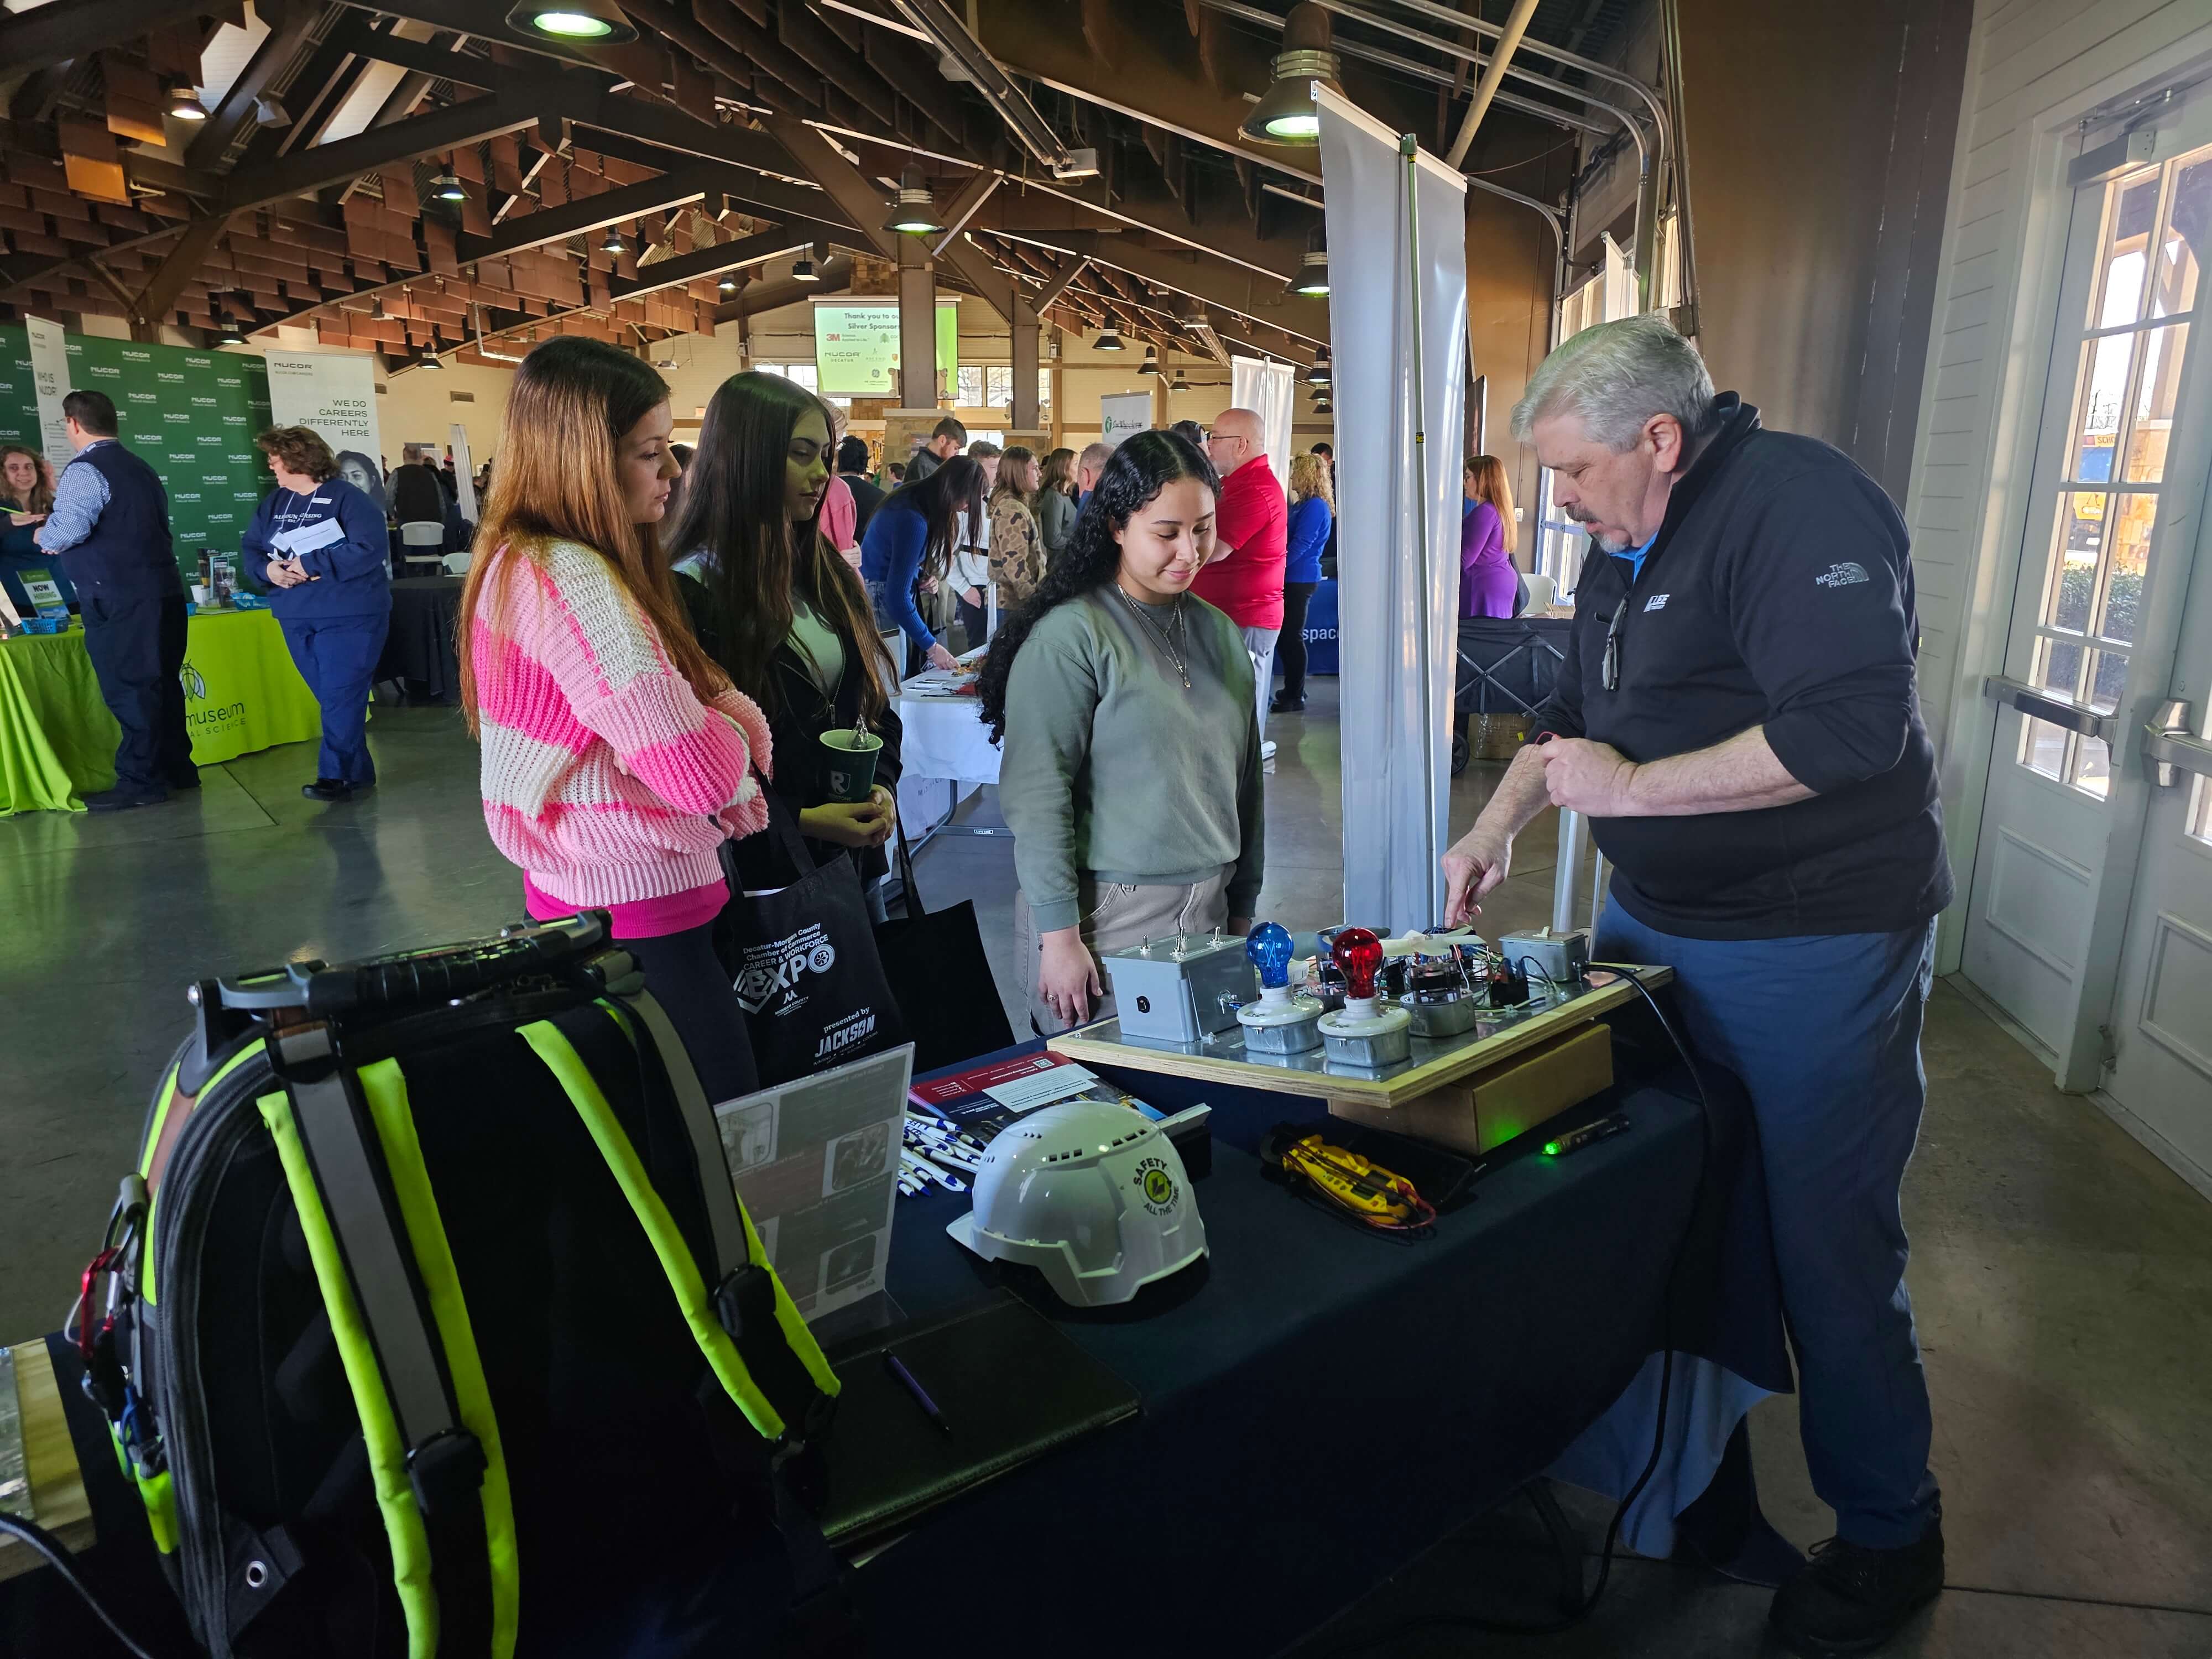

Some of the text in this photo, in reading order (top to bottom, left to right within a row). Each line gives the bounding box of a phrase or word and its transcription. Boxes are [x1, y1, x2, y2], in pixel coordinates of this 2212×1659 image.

[319, 409, 367, 417] CAREERS
[299, 418, 368, 426] DIFFERENTLY
[2097, 435, 2115, 444] SCHO
[1829, 563, 1850, 572] THE
[1815, 570, 1851, 585] NORTH
[1828, 576, 1855, 588] FACE
[34, 591, 57, 600] HIRING
[1302, 628, 1338, 643] spac
[186, 702, 244, 727] museum
[743, 923, 821, 954] Decatur-Morgan County
[747, 950, 779, 961] Chamber
[787, 931, 821, 949] Commerce
[744, 958, 776, 970] CAREER
[784, 934, 829, 960] WORKFORCE
[791, 996, 809, 1006] COUNTY
[823, 1011, 859, 1034] presented
[815, 1014, 875, 1058] JACKSON
[1133, 1157, 1167, 1186] SAFETY
[1144, 1185, 1179, 1217] ALL THE TIME
